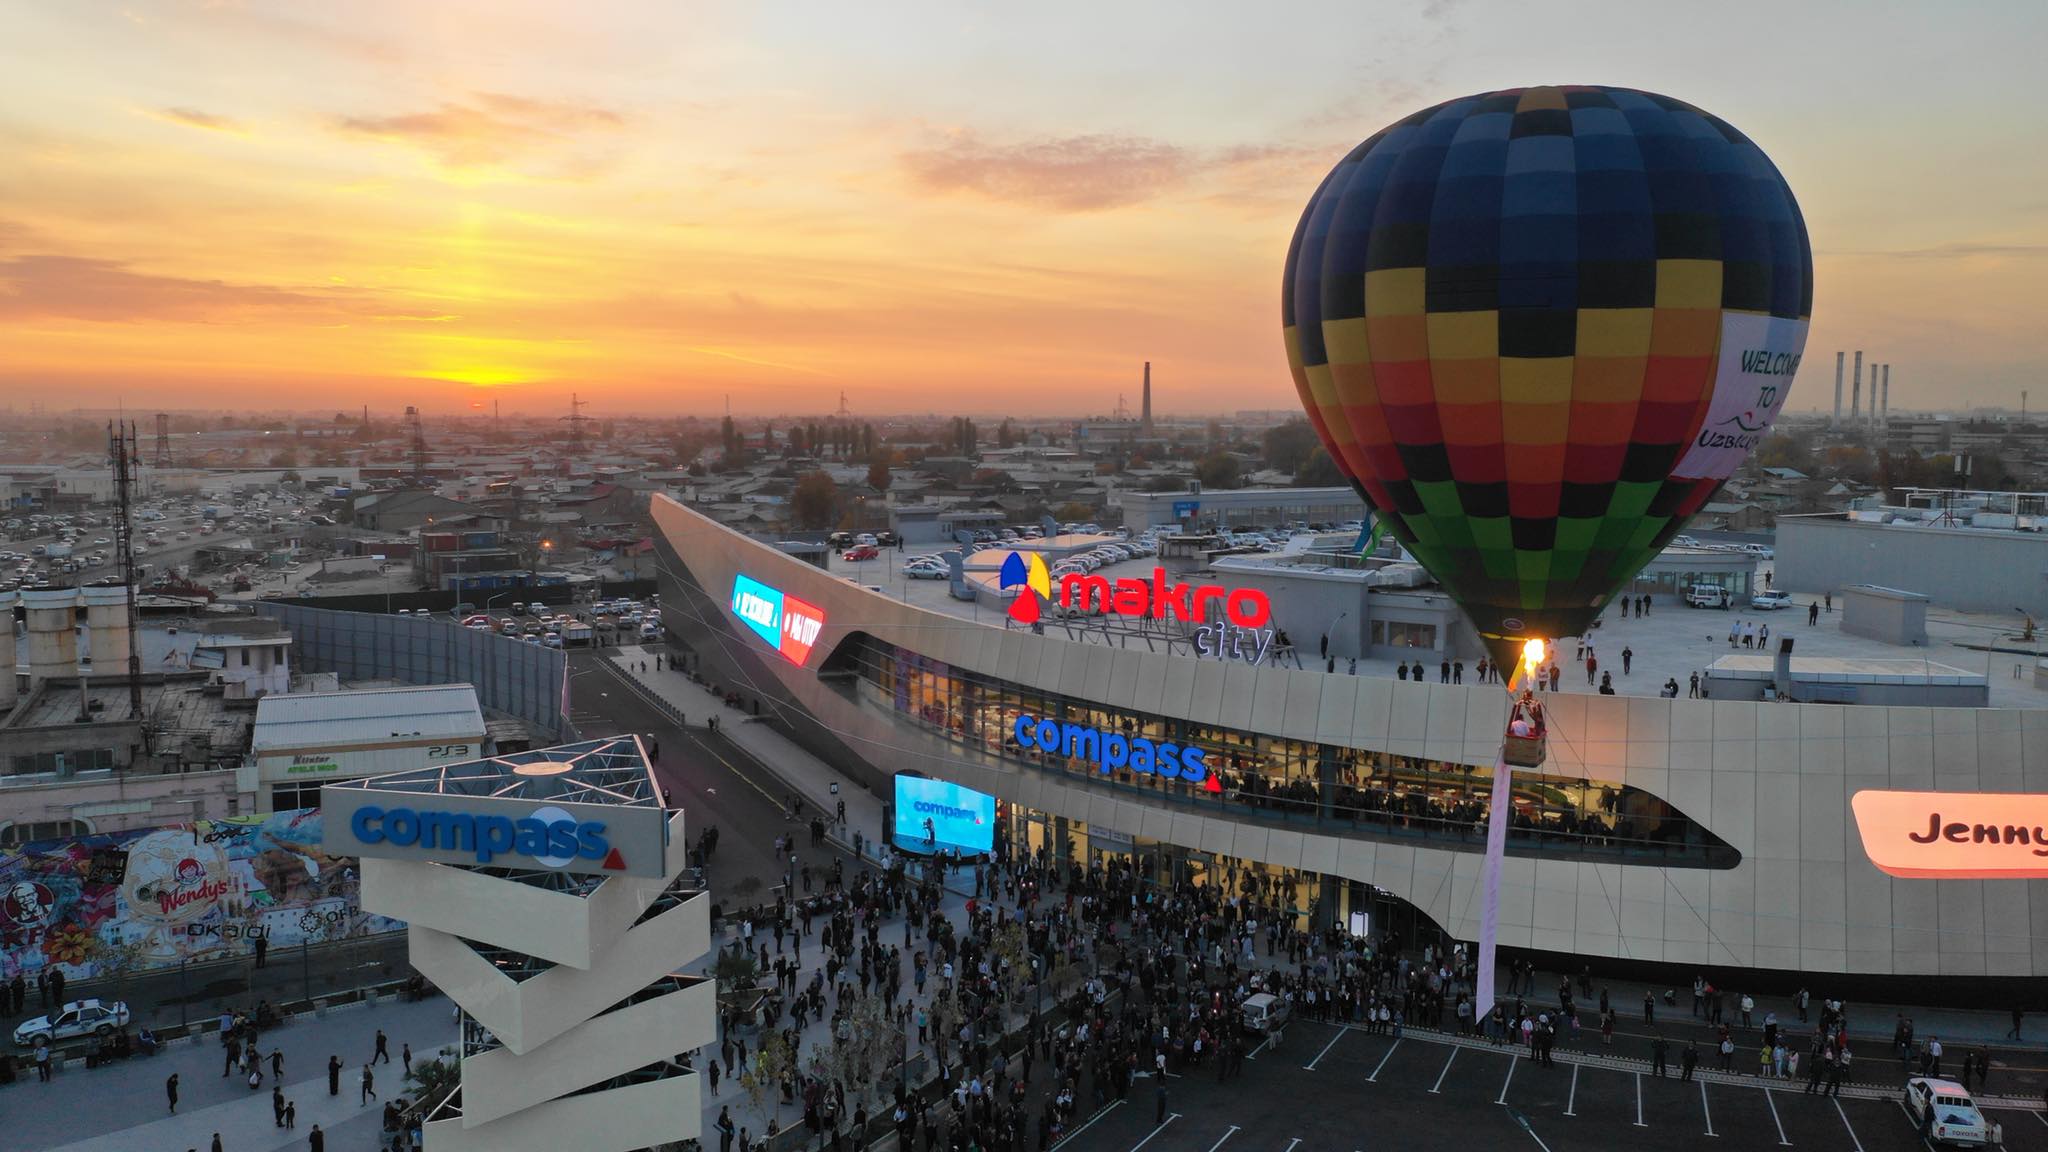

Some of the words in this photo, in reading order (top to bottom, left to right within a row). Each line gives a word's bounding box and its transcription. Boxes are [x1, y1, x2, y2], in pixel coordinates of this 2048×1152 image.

[1756, 386, 1777, 408] TO
[1061, 567, 1271, 628] makro
[1194, 621, 1273, 666] city
[428, 744, 469, 757] PS3
[1014, 714, 1206, 783] compass
[913, 799, 976, 821] compass
[351, 806, 609, 863] compass
[159, 880, 228, 914] Wendy's
[1952, 1129, 1979, 1138] TOYOTA
